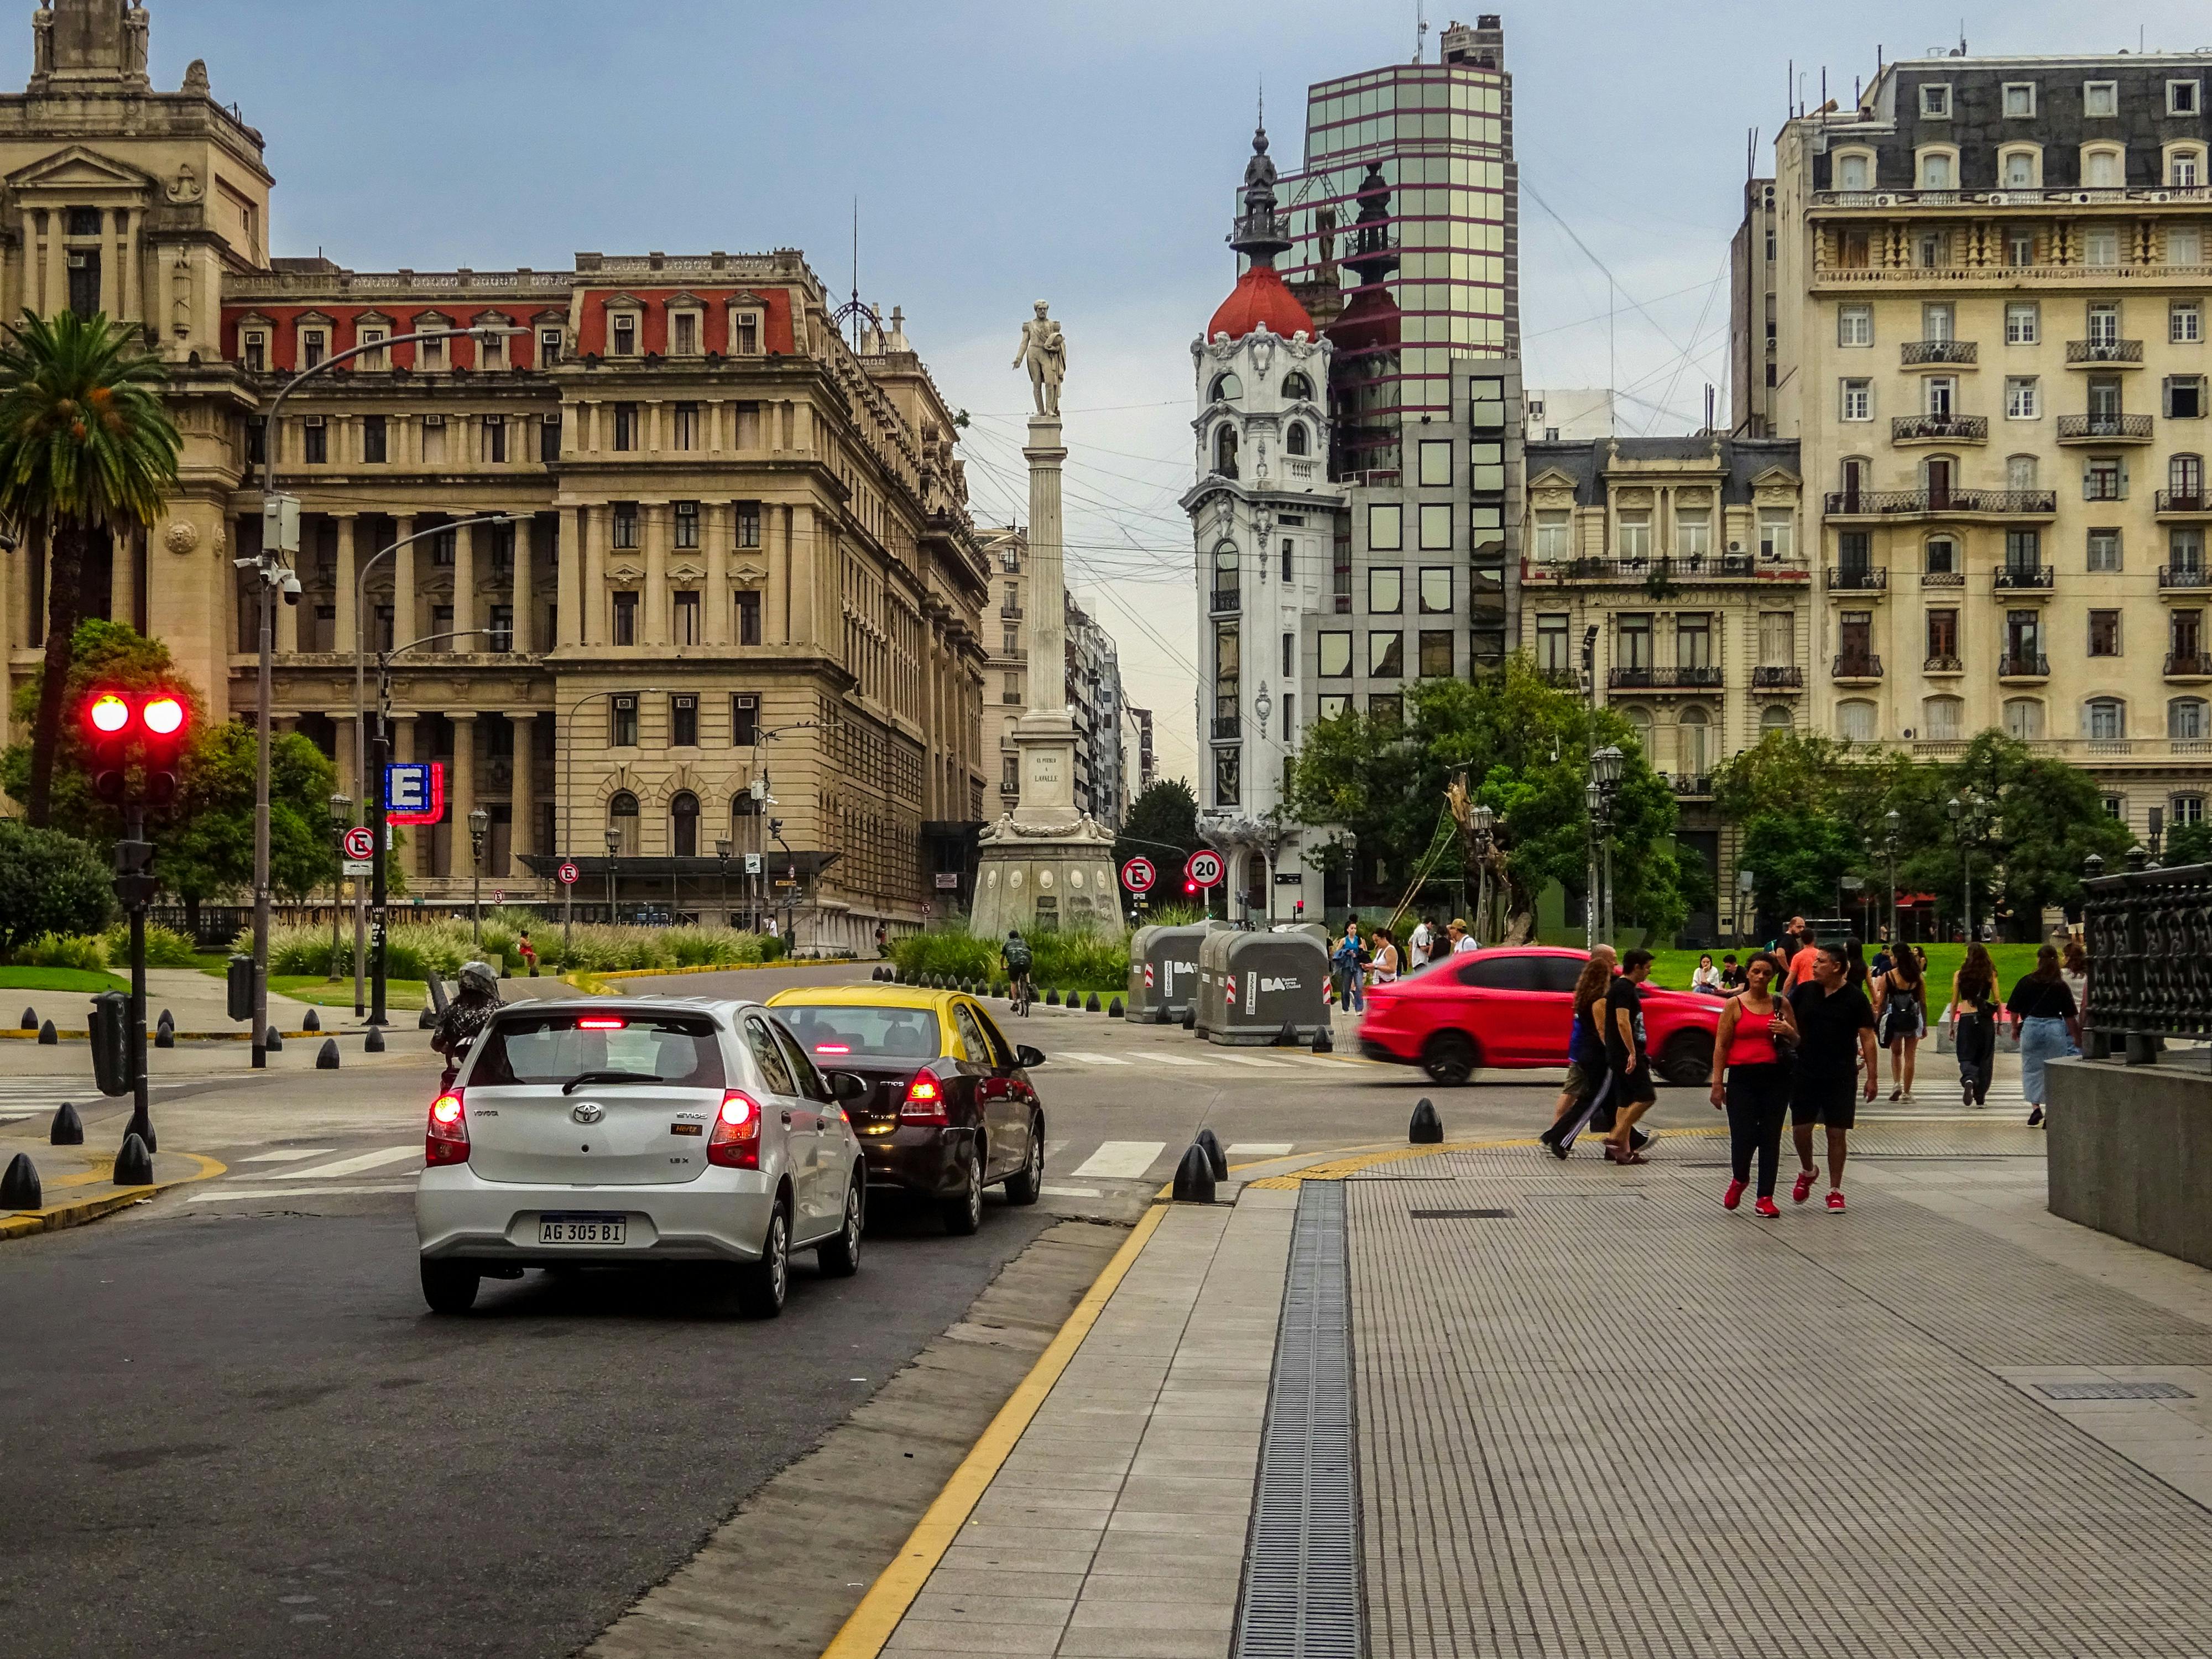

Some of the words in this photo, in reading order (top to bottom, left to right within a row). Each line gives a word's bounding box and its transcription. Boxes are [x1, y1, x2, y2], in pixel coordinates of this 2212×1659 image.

[392, 768, 422, 806] E
[1195, 861, 1216, 877] 20
[1174, 961, 1194, 974] BA
[1261, 977, 1286, 992] BA
[676, 1112, 708, 1120] ETIOS
[544, 1224, 563, 1240] AG
[568, 1225, 596, 1240] 305
[602, 1225, 620, 1241] BI
